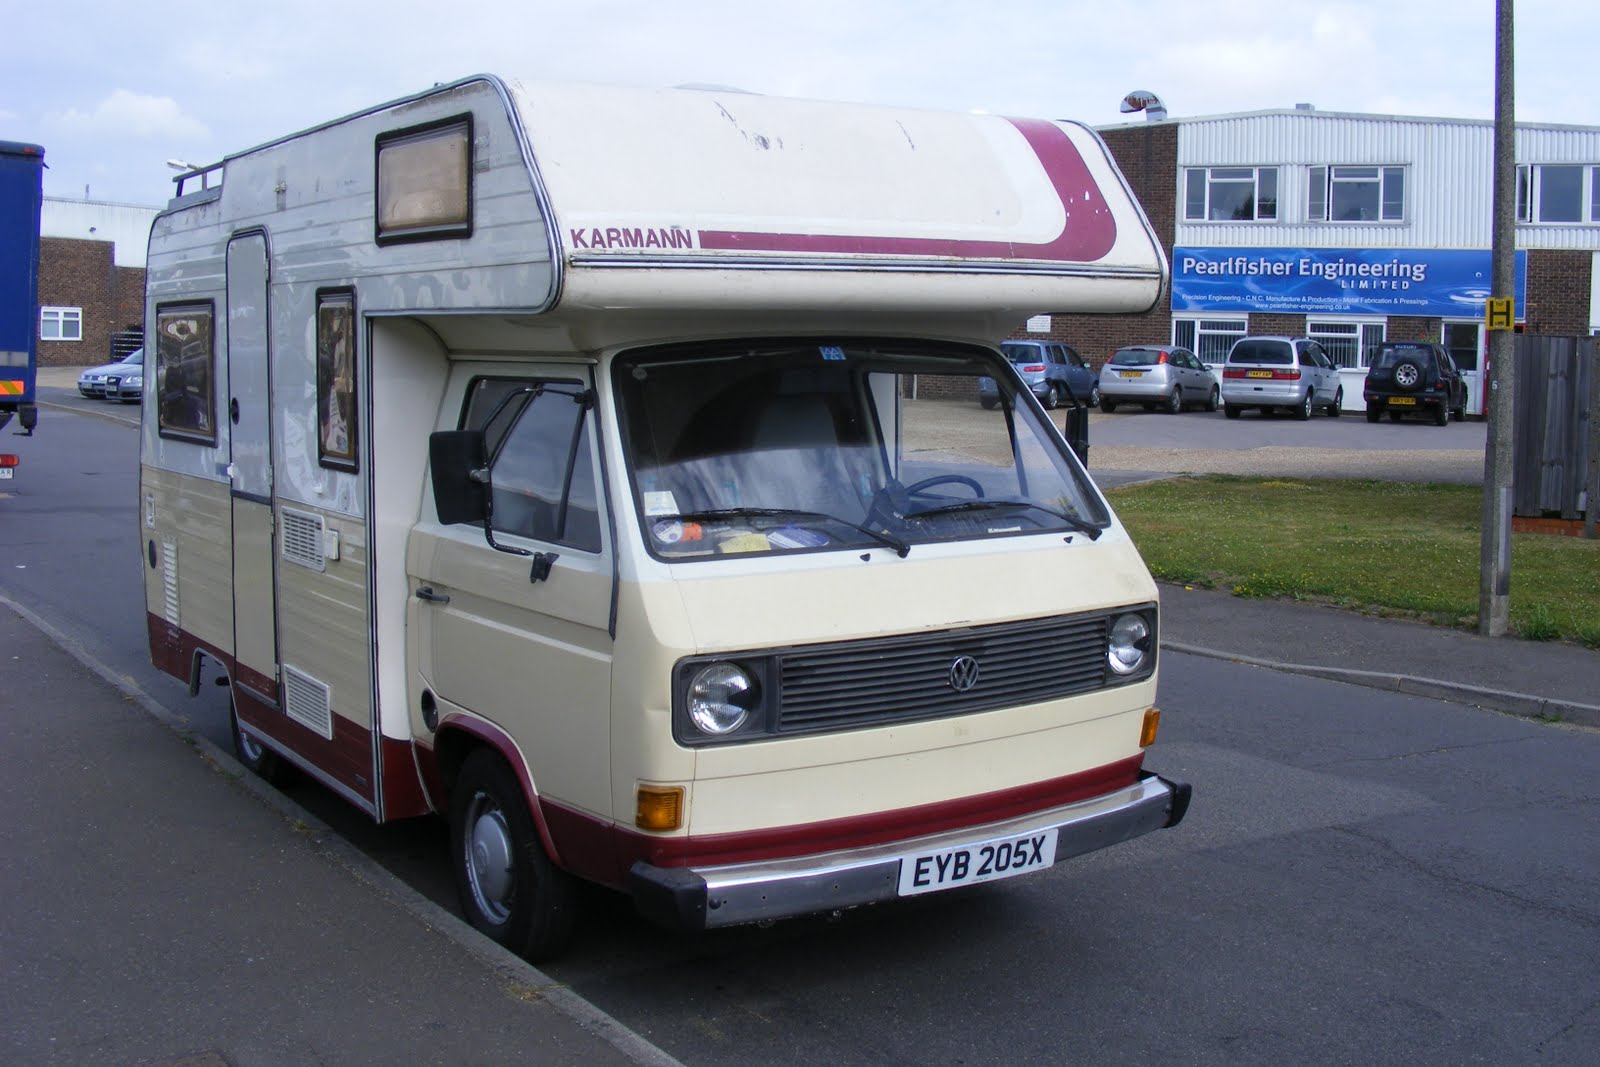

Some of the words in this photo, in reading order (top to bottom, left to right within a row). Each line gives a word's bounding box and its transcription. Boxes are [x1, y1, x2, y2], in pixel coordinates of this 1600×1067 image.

[570, 227, 693, 249] KARMANN
[1183, 256, 1294, 276] Pearlfisher
[1299, 257, 1427, 282] Engineering
[1341, 279, 1410, 290] LIMITED
[1181, 293, 1207, 301] Precision
[1208, 294, 1241, 303] Engineering
[1308, 296, 1338, 304] Production
[1400, 298, 1429, 306] Pressings
[1255, 301, 1351, 311] www.pearlfisher-engineering.co.uk
[1489, 300, 1511, 327] H
[913, 850, 970, 887] EYB
[976, 835, 1046, 876] 205X
